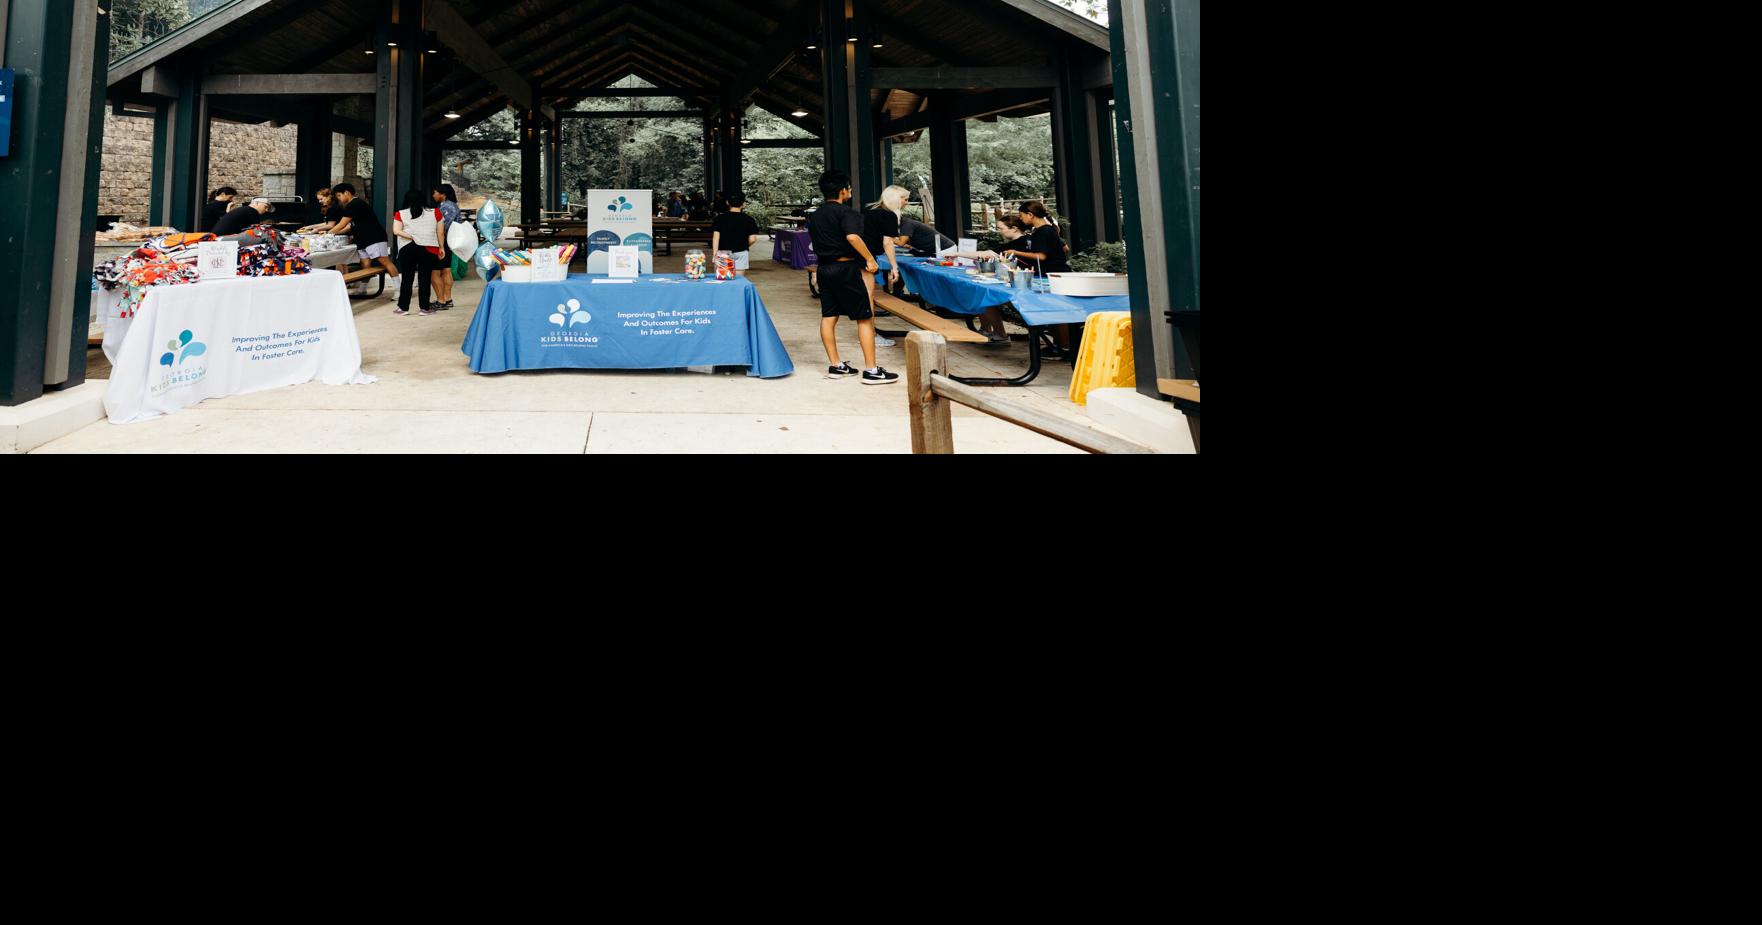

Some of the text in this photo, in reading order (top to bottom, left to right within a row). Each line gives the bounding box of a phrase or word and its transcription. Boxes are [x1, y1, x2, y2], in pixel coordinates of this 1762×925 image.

[617, 311, 656, 320] Improving
[672, 309, 717, 318] Experiences
[694, 317, 712, 325] Kids
[231, 327, 328, 344] Improving The Experiences
[649, 328, 673, 336] Foster
[674, 327, 695, 335] Care.
[235, 345, 253, 353] And
[254, 342, 292, 351] Outcomes
[306, 336, 321, 344] Kids
[261, 351, 285, 361] Foster
[286, 348, 304, 357] Care.
